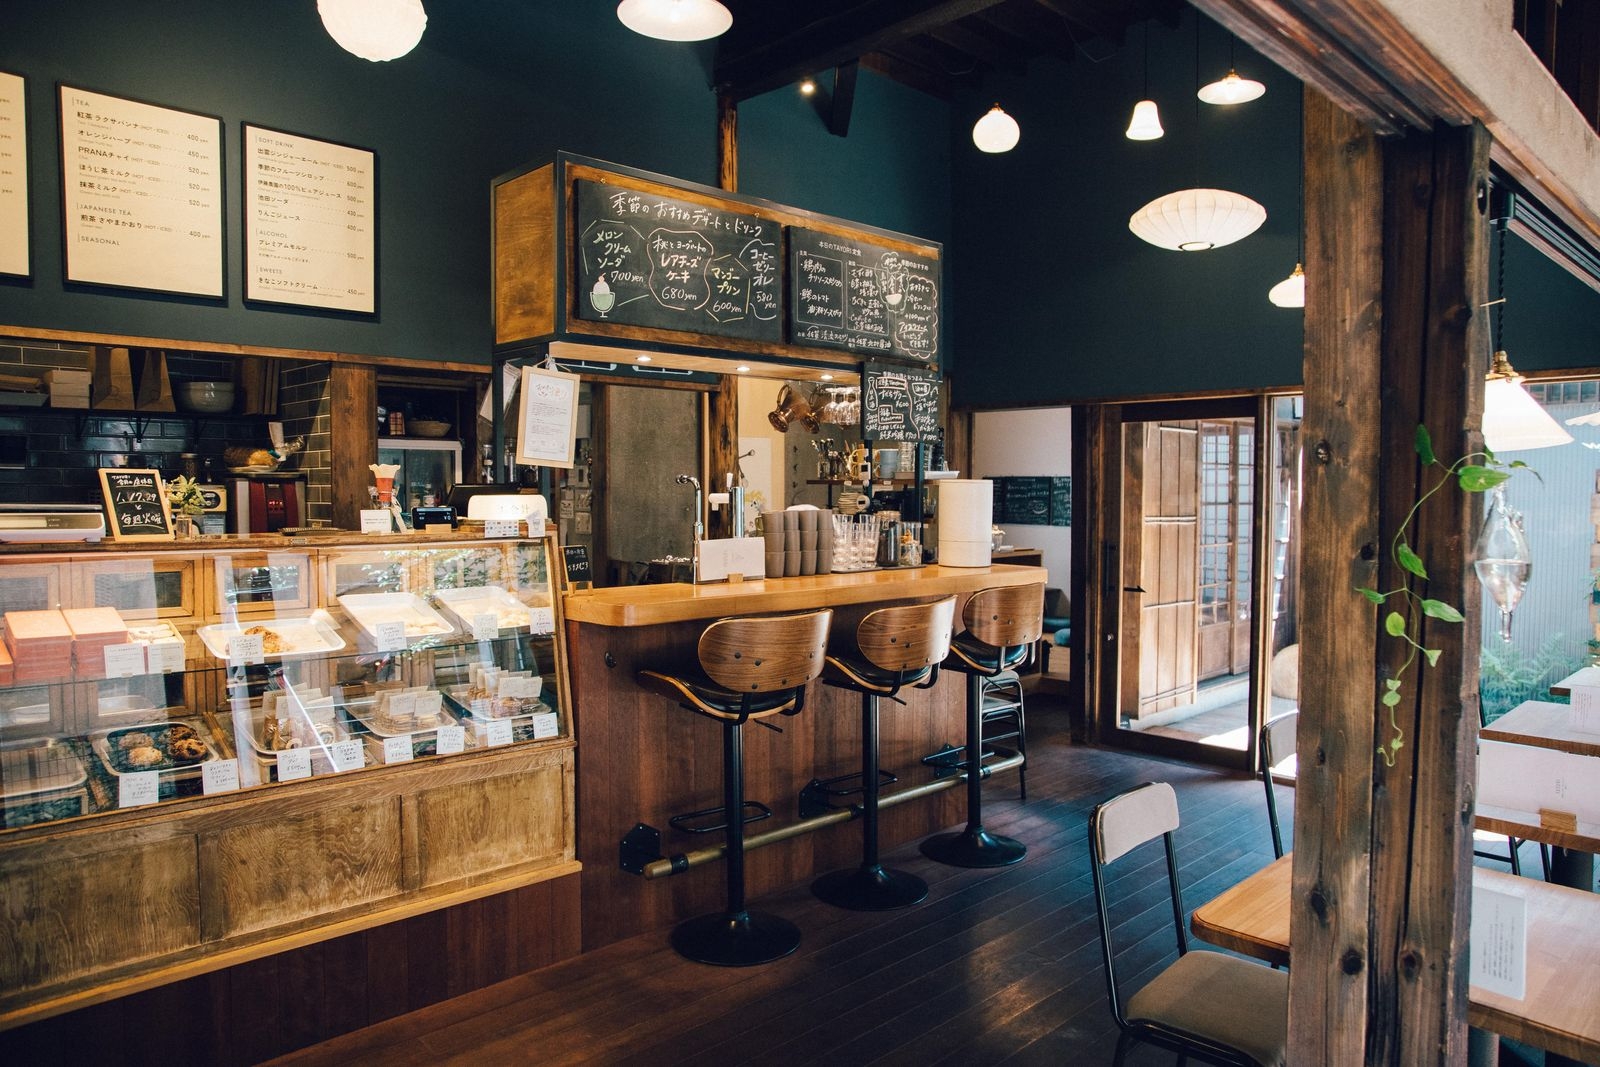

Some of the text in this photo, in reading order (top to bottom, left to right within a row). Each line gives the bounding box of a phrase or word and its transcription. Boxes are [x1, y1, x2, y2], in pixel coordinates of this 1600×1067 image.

[187, 134, 199, 142] 400
[80, 164, 130, 177] ほうじ茶ミルク
[188, 167, 200, 175] 520
[258, 164, 324, 181] 季節のフルーツシロップ
[80, 181, 117, 192] 抹茶ミルク
[80, 204, 117, 214] JAPANESE
[99, 217, 142, 229] さやまかおり
[259, 230, 288, 238] ALCOHOL
[593, 230, 623, 243] メロン
[81, 236, 120, 246] SEASONAL
[259, 240, 307, 251] プレミアムモルツ
[604, 244, 631, 255] クリーム
[751, 248, 775, 260] コーヒー
[598, 256, 626, 269] ソーダ
[661, 254, 701, 269] レアチーズ
[753, 261, 775, 273] ゼリー
[666, 270, 690, 283] ケーキ
[712, 267, 740, 280] マンゴー
[258, 277, 318, 289] きなこソフトクリーム
[753, 274, 773, 286] オレ
[717, 281, 740, 295] プリン
